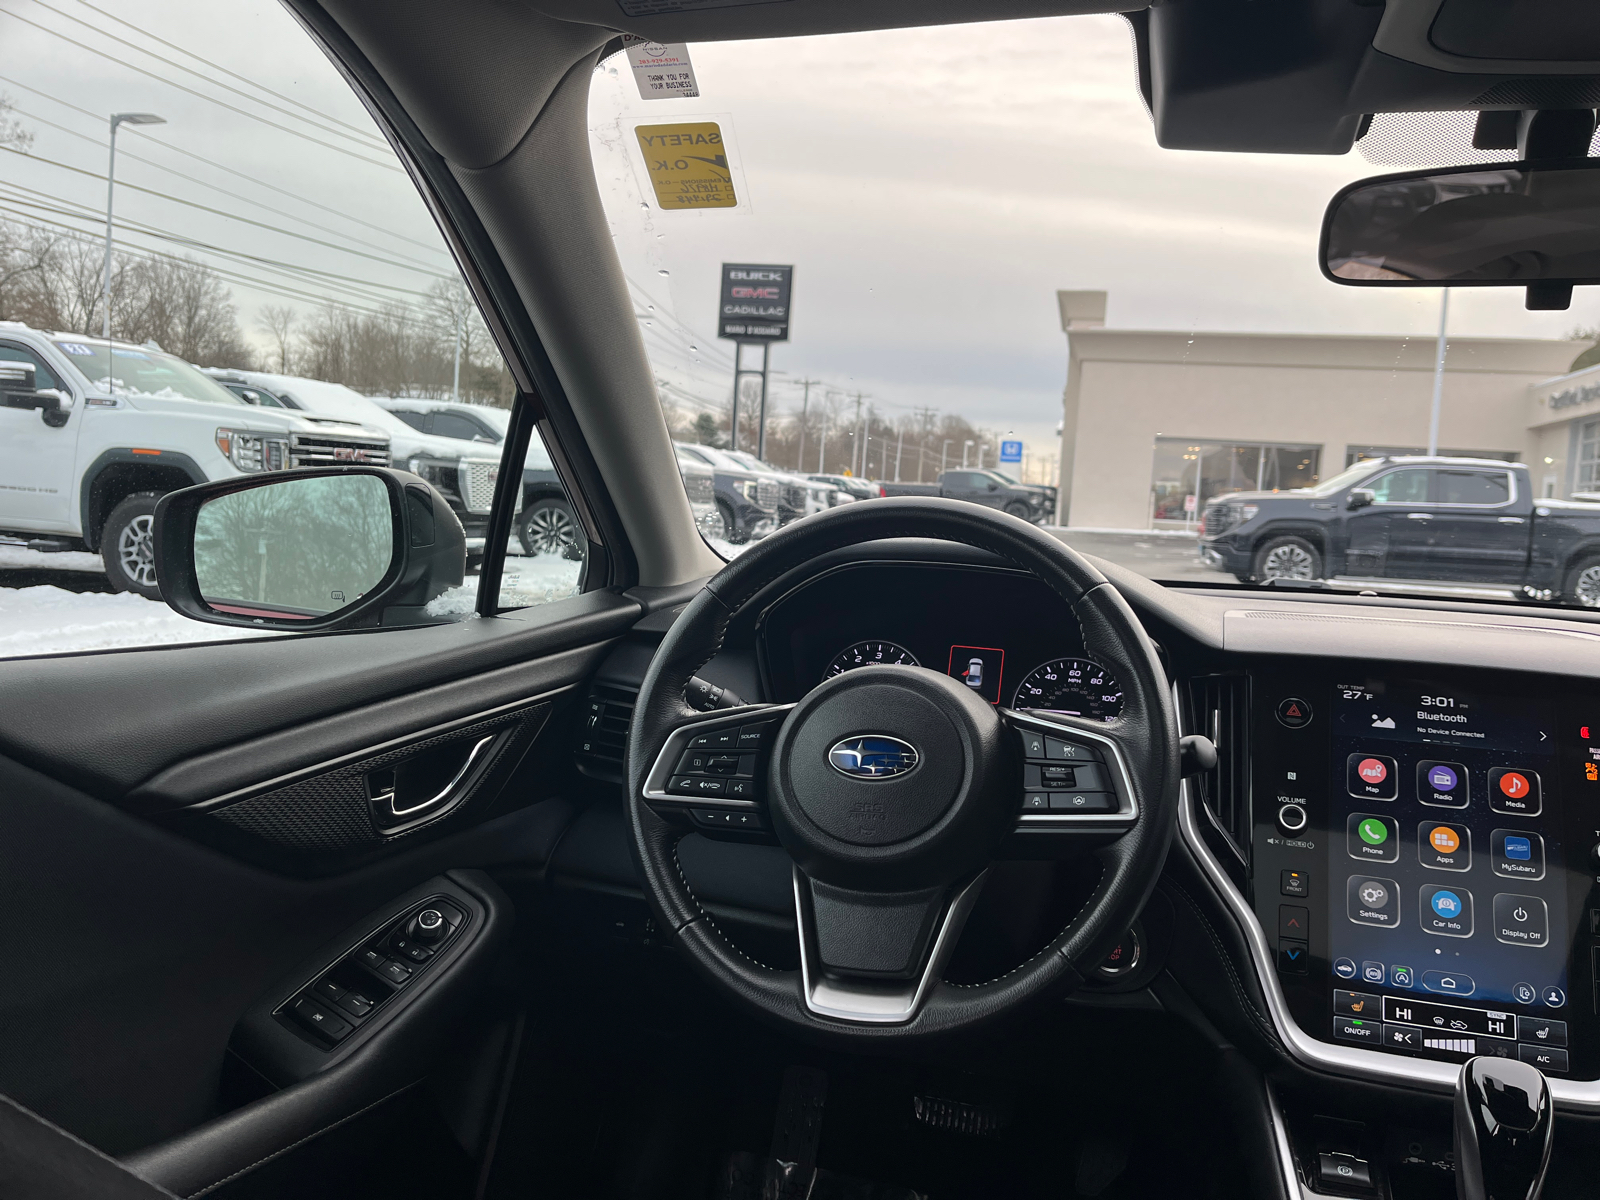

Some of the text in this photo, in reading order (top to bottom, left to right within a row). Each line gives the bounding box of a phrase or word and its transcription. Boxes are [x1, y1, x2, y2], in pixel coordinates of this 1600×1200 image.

[666, 81, 692, 89] BUSINESS
[730, 270, 783, 281] BUICK
[731, 287, 780, 299] GMC
[723, 304, 786, 316] CADILLAC
[875, 652, 883, 660] 3
[1343, 690, 1362, 700] 27
[1420, 695, 1454, 707] 3:01
[1417, 711, 1468, 723] Bluetooth
[1451, 730, 1485, 738] Connected
[1277, 795, 1307, 804] VOLUME
[1433, 793, 1453, 801] Radio
[1505, 800, 1526, 809] Media
[1362, 847, 1384, 855] Phone
[1436, 855, 1454, 864] Apps
[1501, 863, 1536, 873] MySubaru
[1359, 910, 1388, 920] Settings
[1433, 920, 1461, 930] Car Info
[1502, 928, 1541, 940] Display Off
[1395, 1007, 1411, 1020] HI
[1344, 1027, 1371, 1036] ON/OFF
[1488, 1020, 1504, 1034] HI
[1537, 1055, 1550, 1063] A/C
